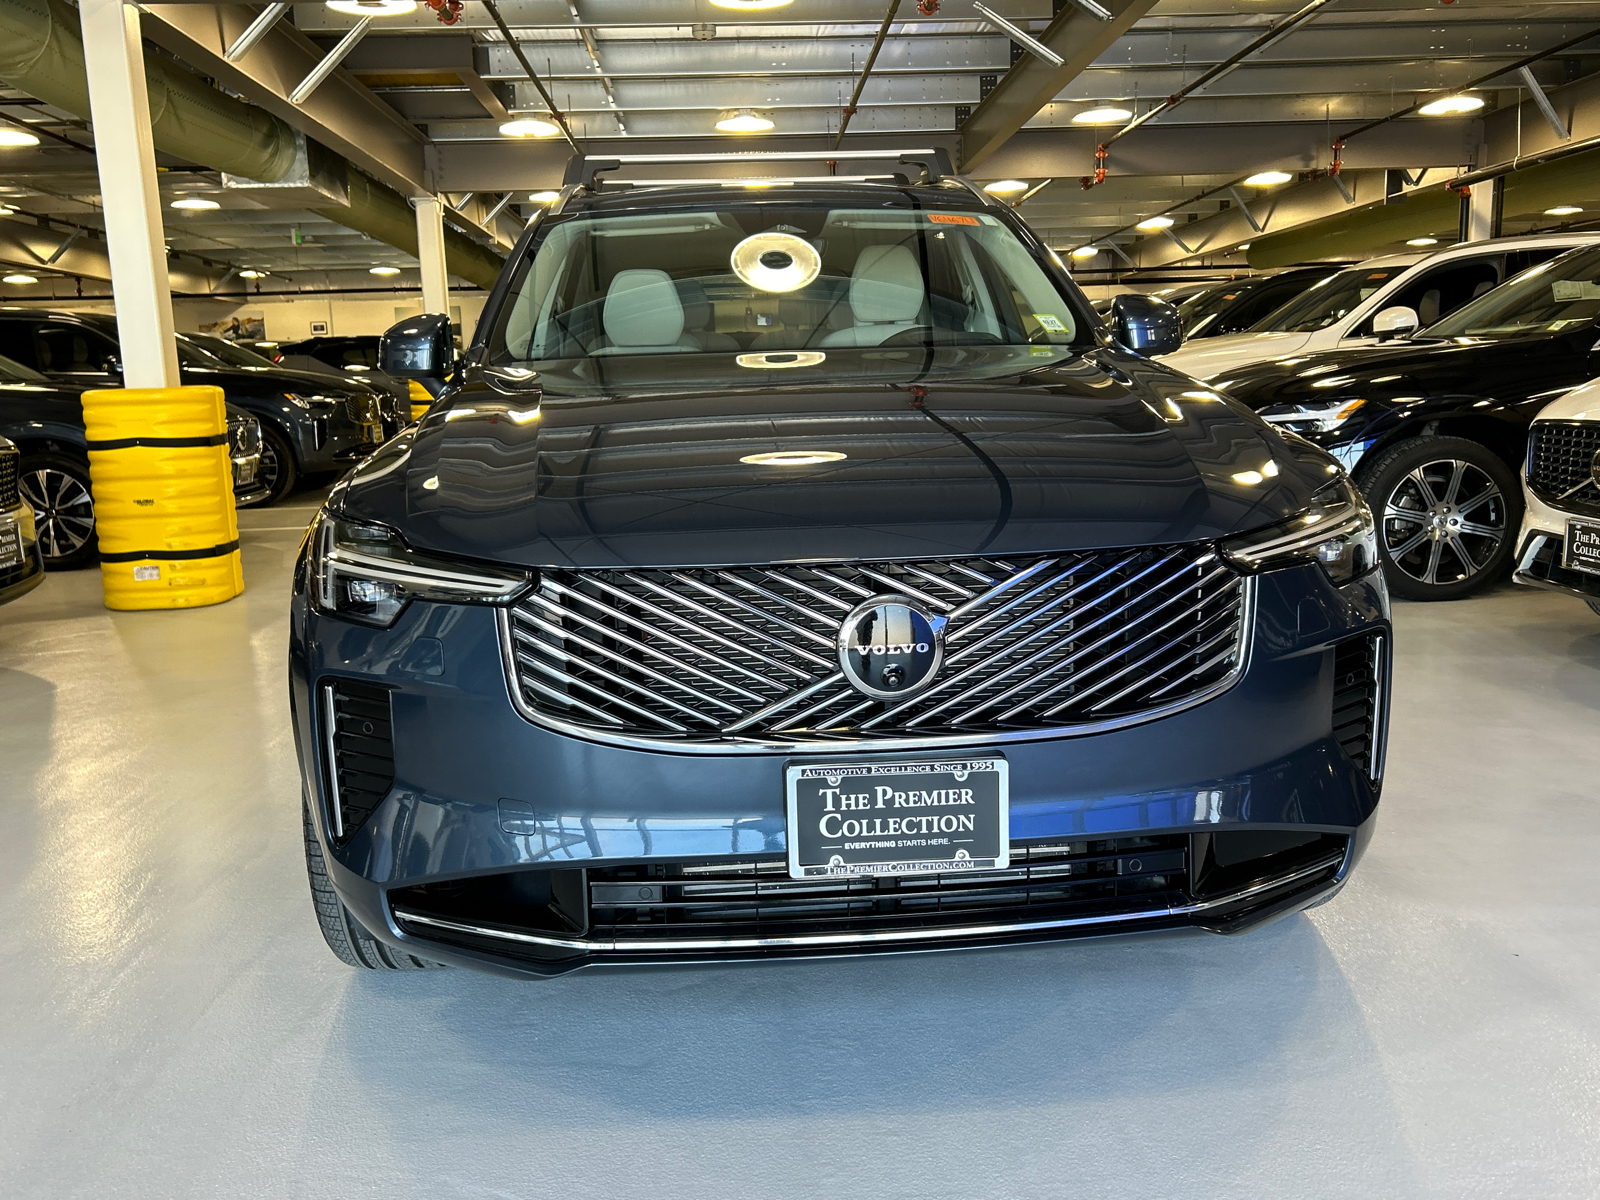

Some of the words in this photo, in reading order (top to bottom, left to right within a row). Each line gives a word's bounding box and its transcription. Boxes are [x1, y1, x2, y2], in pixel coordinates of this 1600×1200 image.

[1575, 530, 1590, 543] THE
[854, 642, 929, 656] VOLVO
[804, 767, 867, 777] AUTOMOTIVE
[871, 765, 931, 774] EXCELLENCE
[933, 763, 963, 772] SINCE
[966, 761, 993, 771] 1995
[819, 787, 871, 811] THE
[874, 785, 975, 809] PREMIER
[819, 813, 975, 838] COLLECTION
[844, 841, 896, 849] EVERYTHING
[897, 839, 927, 847] STARTS
[928, 838, 951, 846] HERE.
[825, 861, 975, 875] THEPREMIERCOLLECTION.COM
